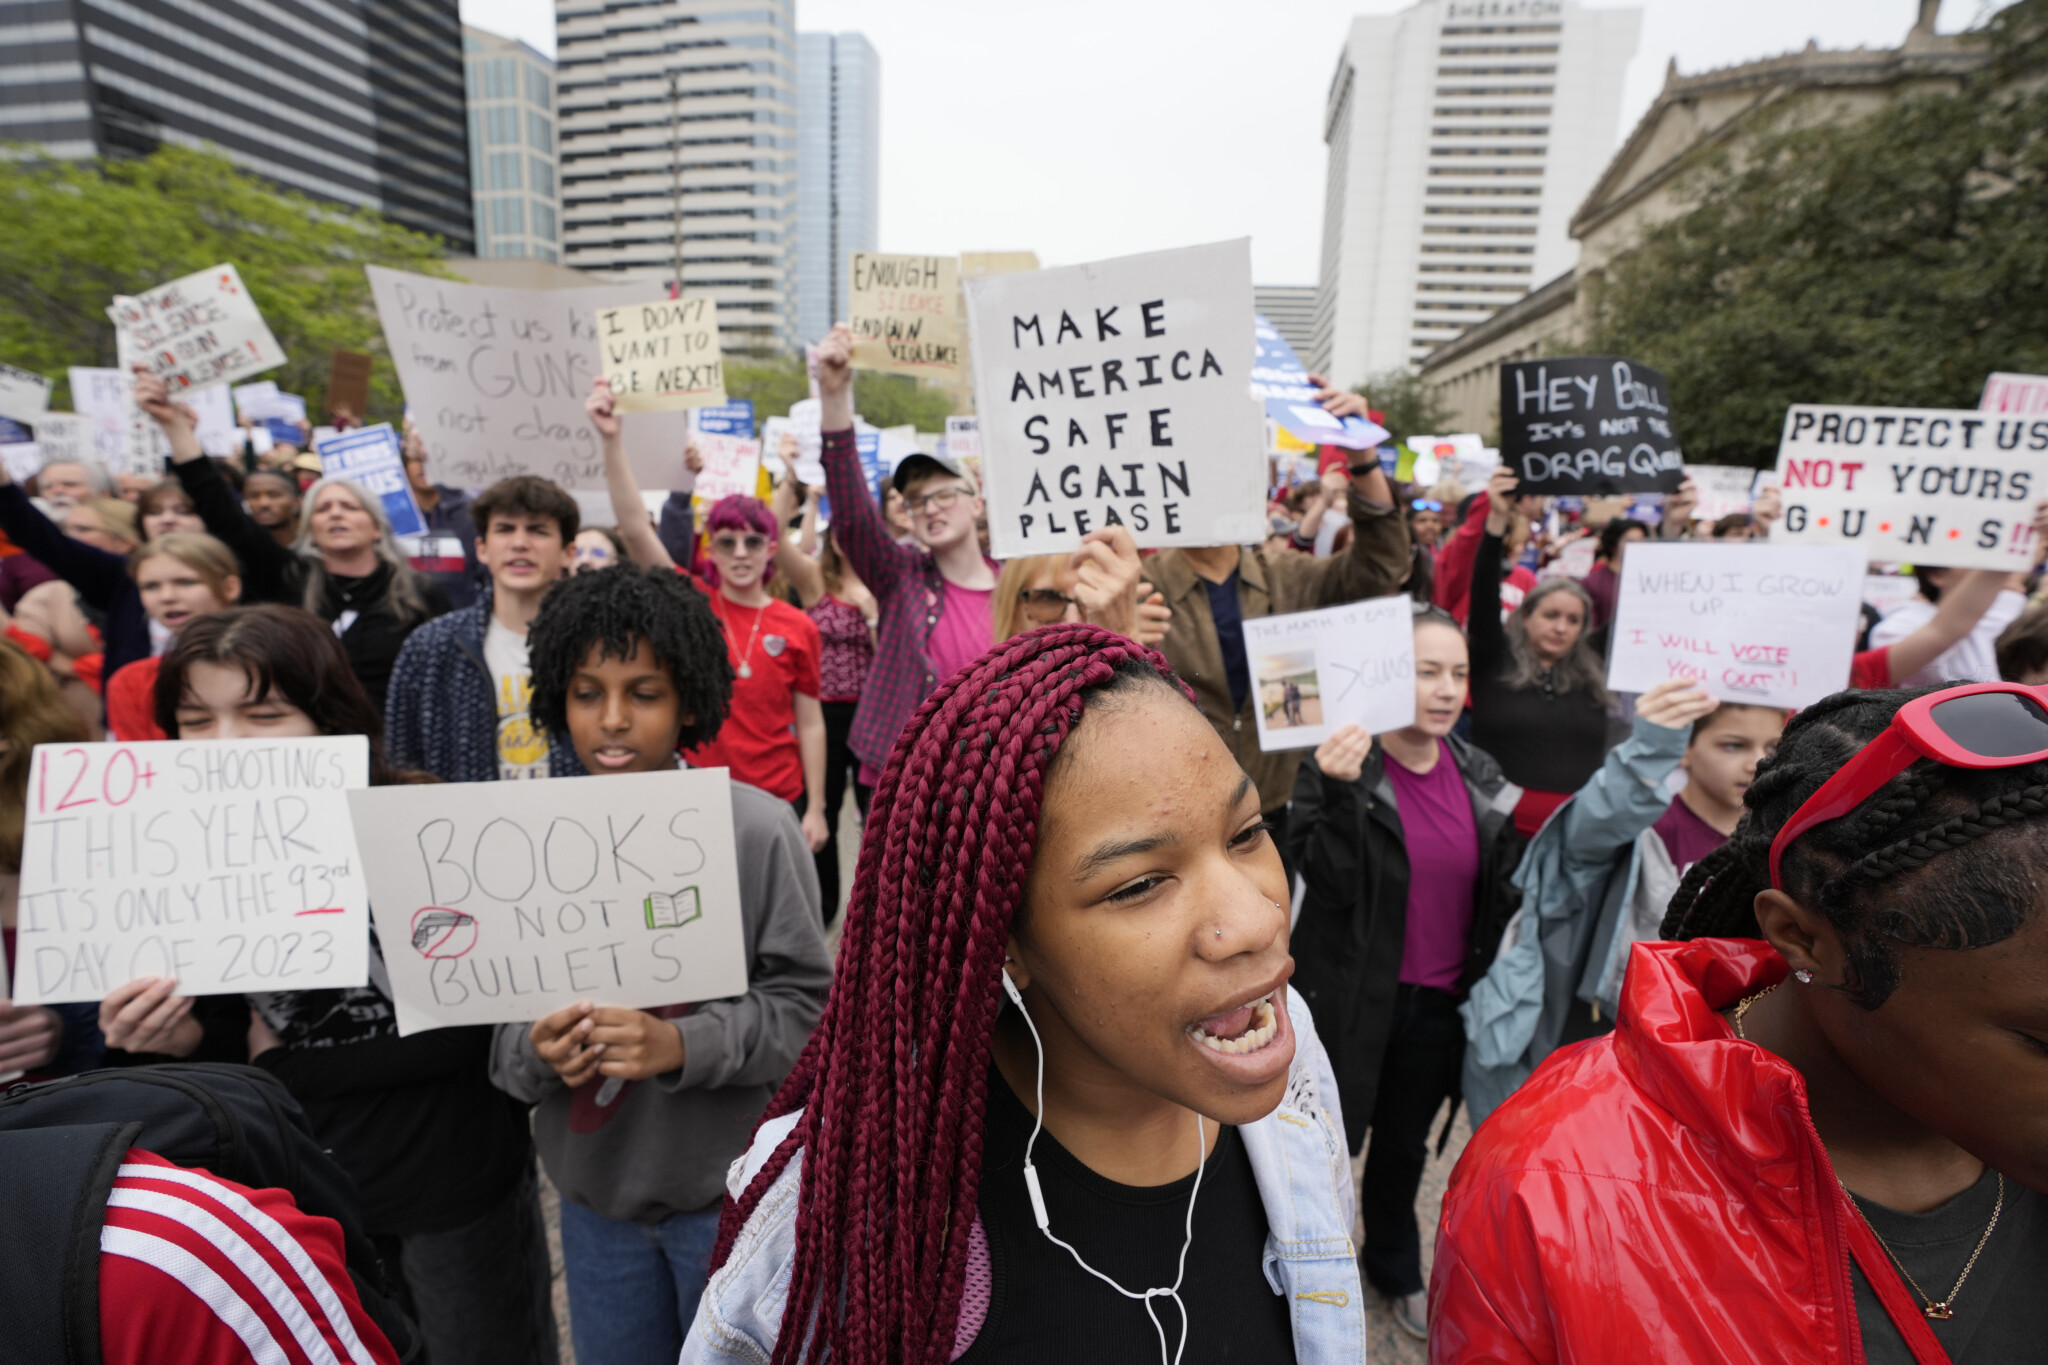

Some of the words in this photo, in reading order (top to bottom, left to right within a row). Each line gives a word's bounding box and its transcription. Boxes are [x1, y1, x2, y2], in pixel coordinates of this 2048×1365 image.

[854, 253, 939, 291] ENOUGH
[394, 282, 498, 340] Protect
[511, 316, 552, 343] us
[603, 311, 624, 337] I
[642, 299, 706, 333] DON'T
[876, 290, 944, 315] SILENCE
[1013, 299, 1166, 349] MAKE
[608, 336, 671, 365] WANT
[683, 330, 709, 354] TO
[608, 369, 642, 396] BE
[655, 360, 720, 392] NEXT!
[1011, 348, 1223, 402] AMERICA
[1515, 366, 1598, 414] HEY
[437, 404, 489, 434] not
[1024, 408, 1173, 455] SAFE
[1599, 416, 1640, 437] NOT
[1789, 412, 1984, 449] PROTECT
[1997, 420, 2048, 451] US
[1522, 445, 1626, 481] DRAG
[1784, 459, 1863, 490] NOT
[1891, 464, 2031, 501] YOURS
[1023, 460, 1190, 507] AGAIN
[1019, 502, 1181, 539] PLEASE
[1638, 571, 1714, 595] WHEN
[1722, 572, 1742, 593] I
[1756, 574, 1844, 597] GROW
[1629, 629, 1648, 645] I
[1658, 633, 1720, 655] WILL
[1731, 643, 1789, 664] VOTE
[1667, 659, 1708, 682] YOU
[39, 748, 158, 815] 120+
[174, 747, 345, 793] SHOOTINGS
[29, 810, 179, 884] THIS
[190, 795, 321, 871] YEAR
[417, 808, 705, 905] BOOKS
[20, 887, 98, 934] IT'S
[114, 882, 202, 933] ONLY
[208, 871, 277, 923] THE
[288, 857, 352, 912] 93rd
[514, 900, 618, 940] NOT
[34, 942, 111, 997] DAY
[130, 936, 195, 986] OF
[217, 930, 334, 983] 2023
[430, 933, 682, 1006] BULLETS
